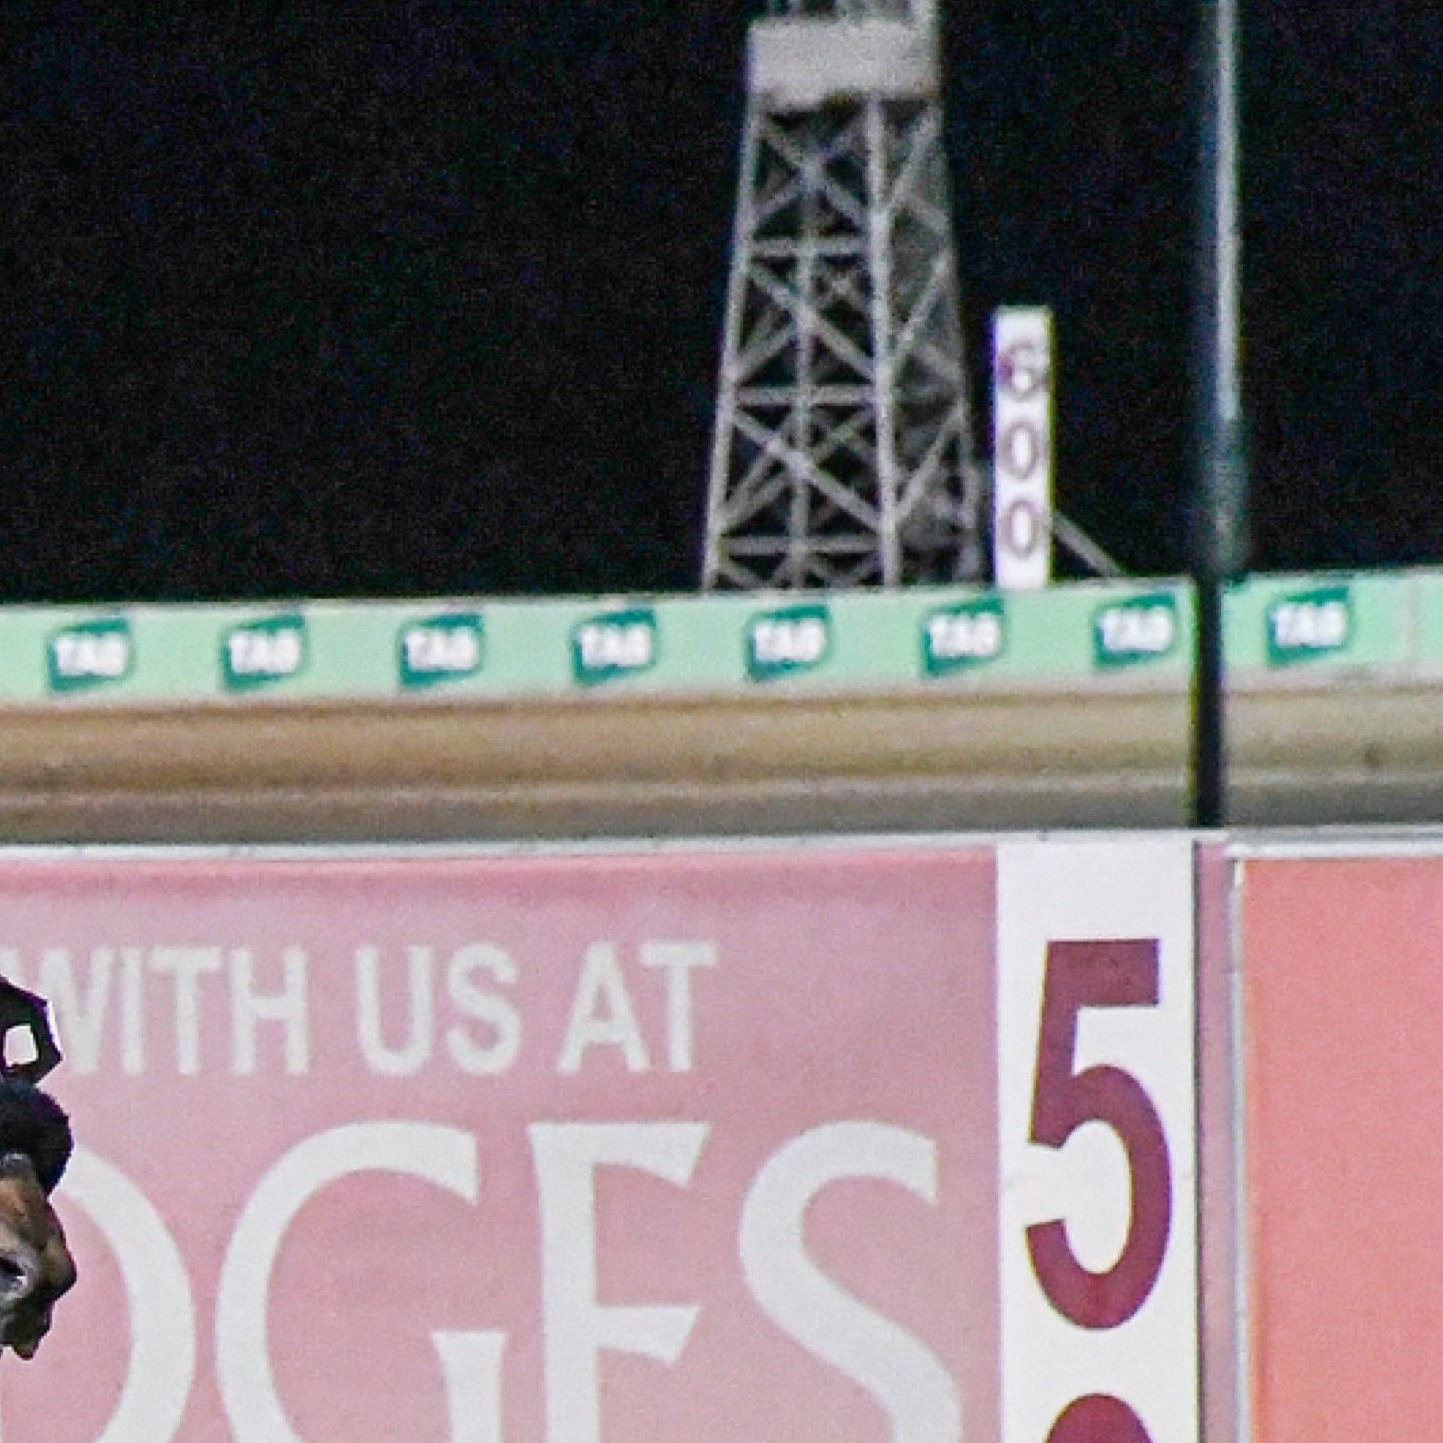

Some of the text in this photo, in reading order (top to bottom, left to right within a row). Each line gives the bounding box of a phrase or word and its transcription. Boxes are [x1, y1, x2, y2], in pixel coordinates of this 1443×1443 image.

[996, 338, 1052, 562] 600
[352, 940, 522, 1077] US
[554, 937, 719, 1075] AT
